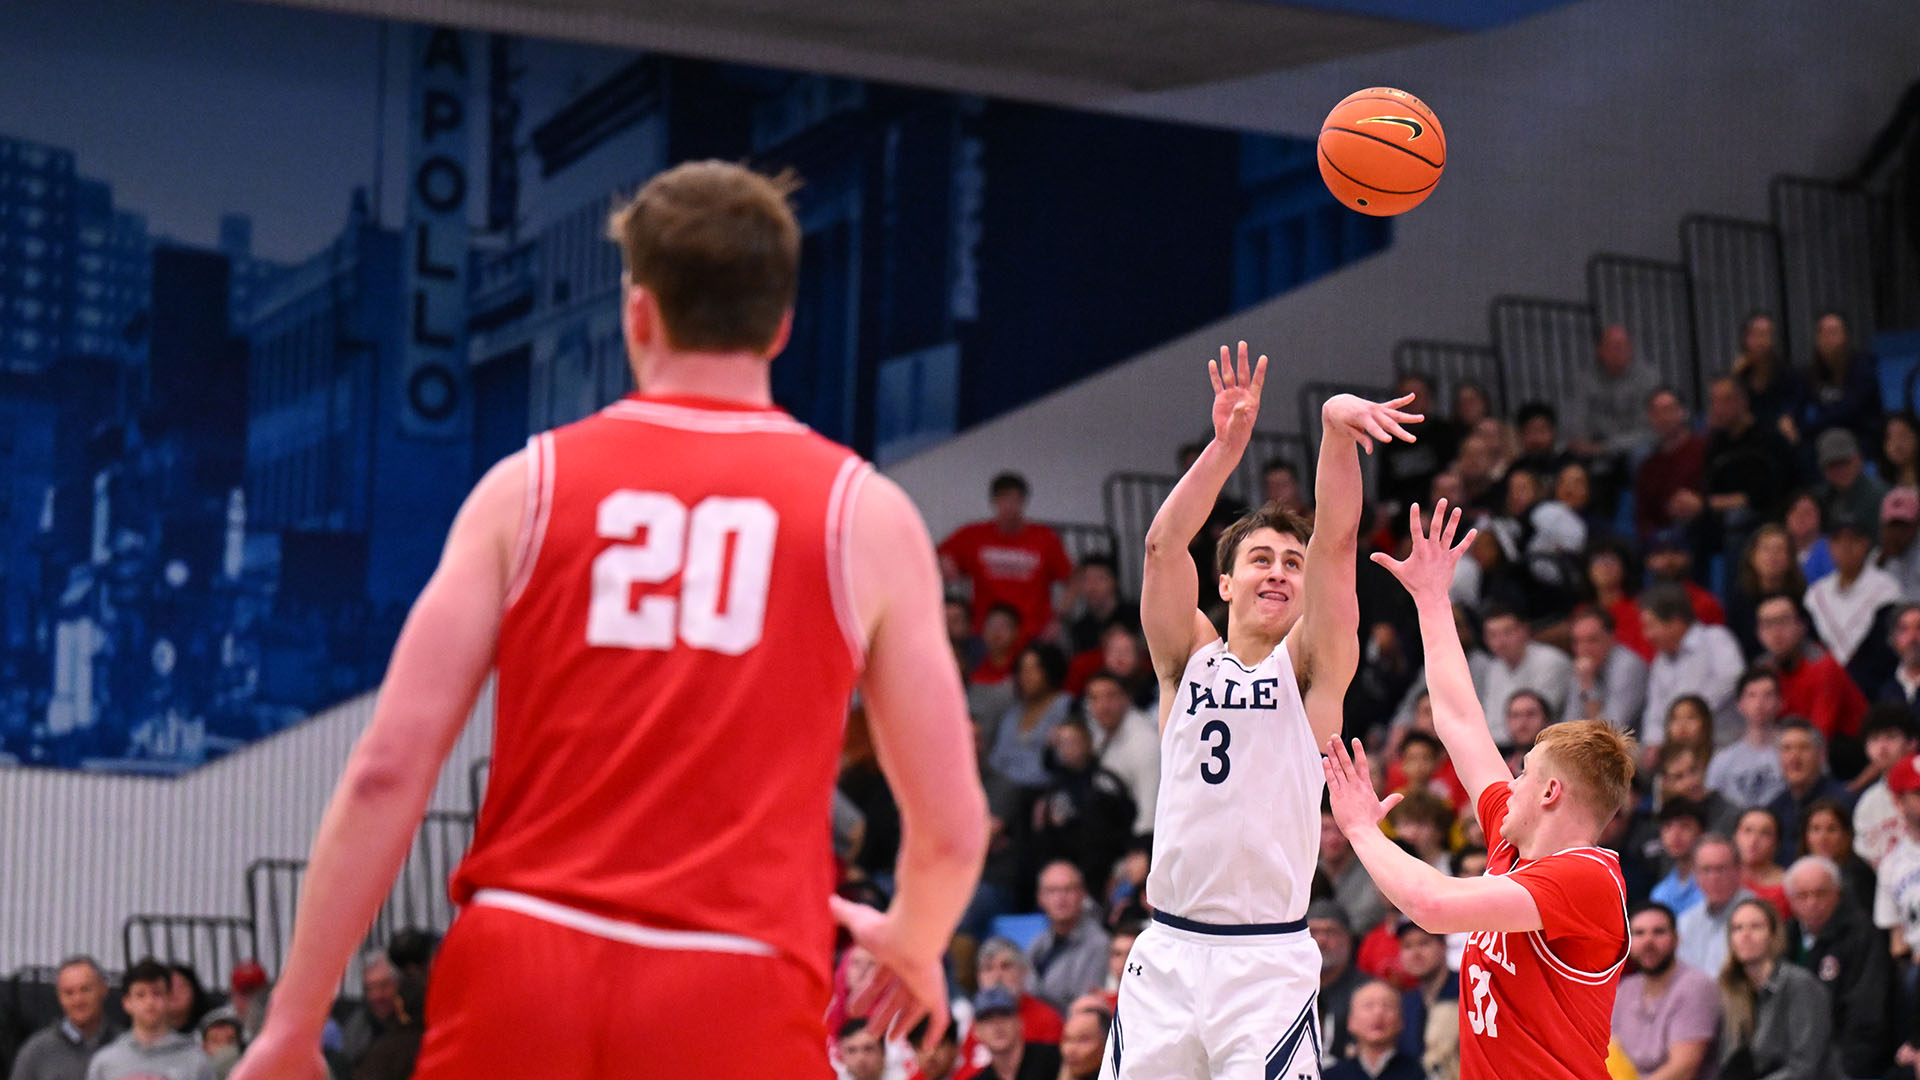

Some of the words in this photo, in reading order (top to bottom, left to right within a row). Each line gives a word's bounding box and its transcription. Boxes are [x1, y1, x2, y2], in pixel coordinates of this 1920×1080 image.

[409, 25, 467, 422] APOLLO
[585, 488, 779, 656] 20
[1200, 719, 1231, 785] 3
[1467, 963, 1499, 1038] 31
